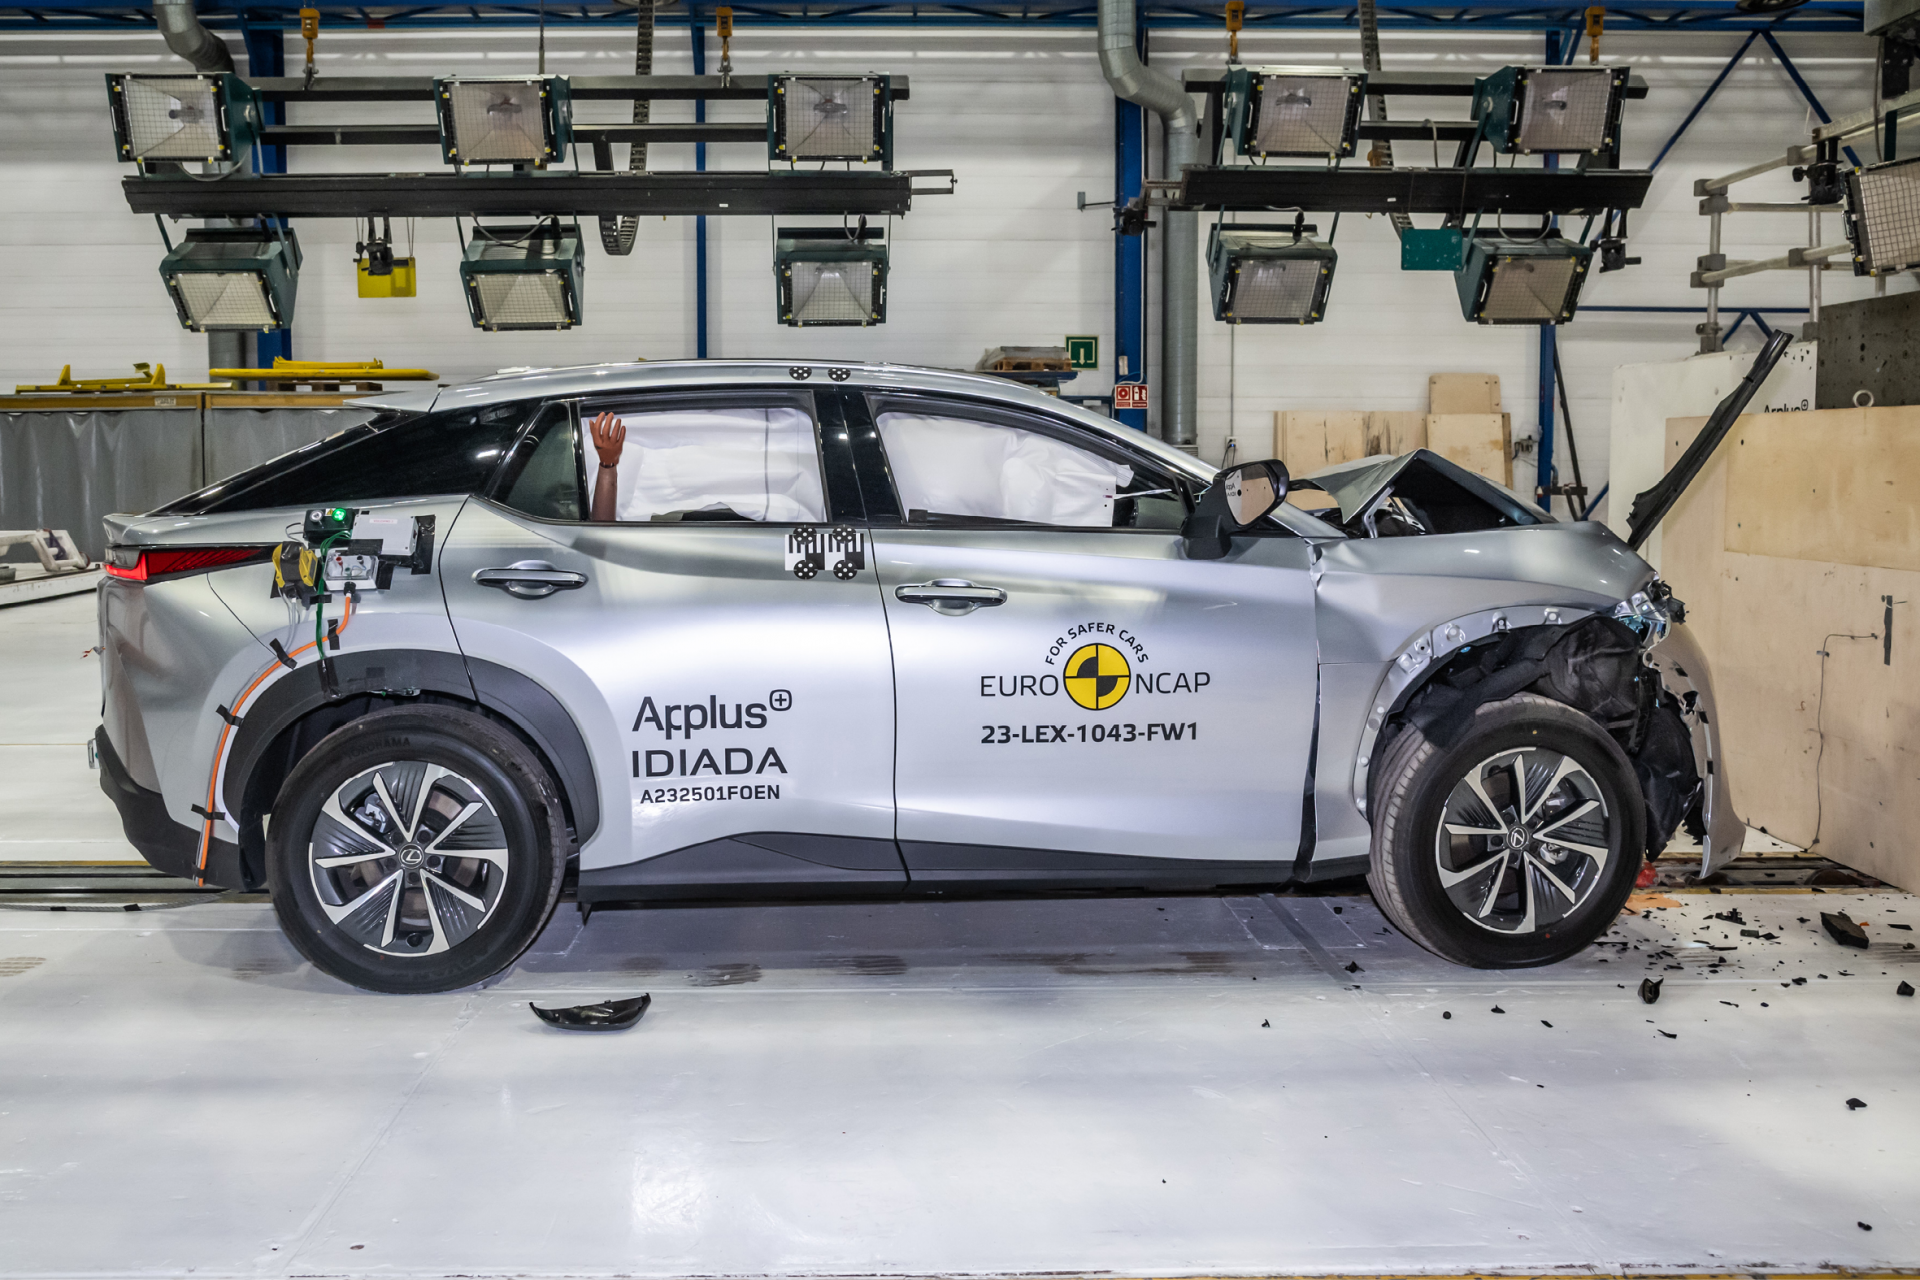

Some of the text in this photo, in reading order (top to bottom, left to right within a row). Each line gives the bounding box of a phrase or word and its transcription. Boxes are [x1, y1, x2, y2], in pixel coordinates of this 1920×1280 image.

[1045, 622, 1149, 666] FOR SAFER CARS
[980, 672, 1211, 697] EURO NCAP
[980, 722, 1197, 744] 23-LEX-1043-FW1
[631, 747, 788, 778] IDIADA
